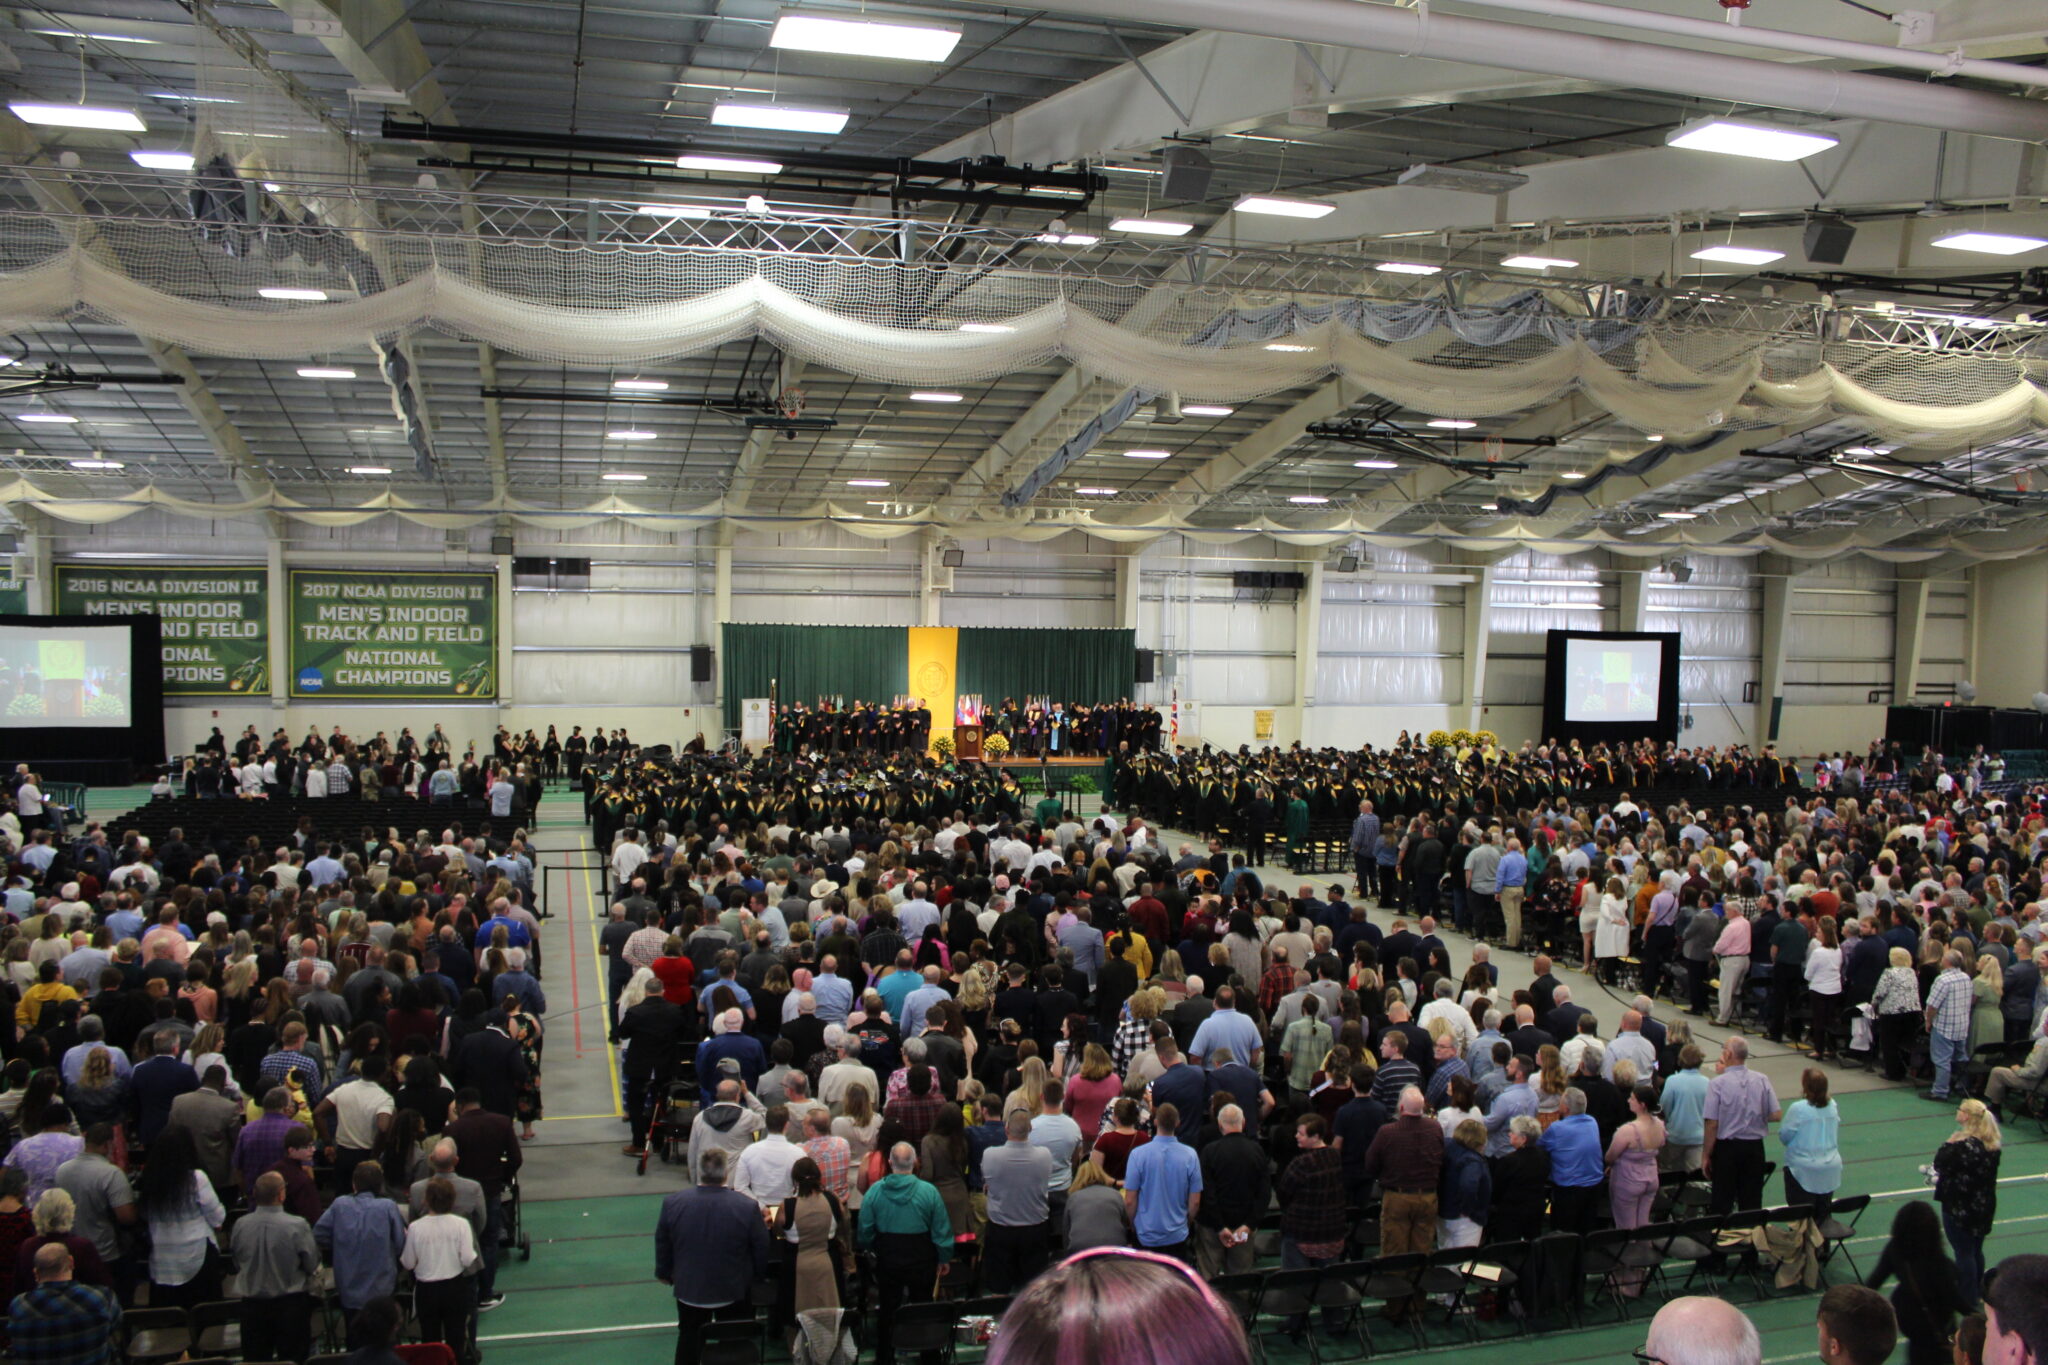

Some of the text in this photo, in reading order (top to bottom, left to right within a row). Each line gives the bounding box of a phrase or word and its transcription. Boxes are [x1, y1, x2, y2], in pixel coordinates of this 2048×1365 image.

[0, 580, 21, 589] ear
[67, 579, 259, 594] 2016 NCAA DIVISION II
[303, 584, 484, 599] 2017 NCAA DIVISION II
[85, 602, 241, 618] MEN'S INDOOR
[319, 606, 468, 622] MEN'S INDOOR
[161, 622, 258, 638] ND FIELD
[303, 625, 483, 642] TRACK AND FIELD
[161, 647, 216, 662] ONAL
[345, 650, 442, 665] NATIONAL
[162, 667, 225, 681] PIONS
[335, 670, 451, 685] CHAMPIONS
[300, 678, 322, 687] NCAA
